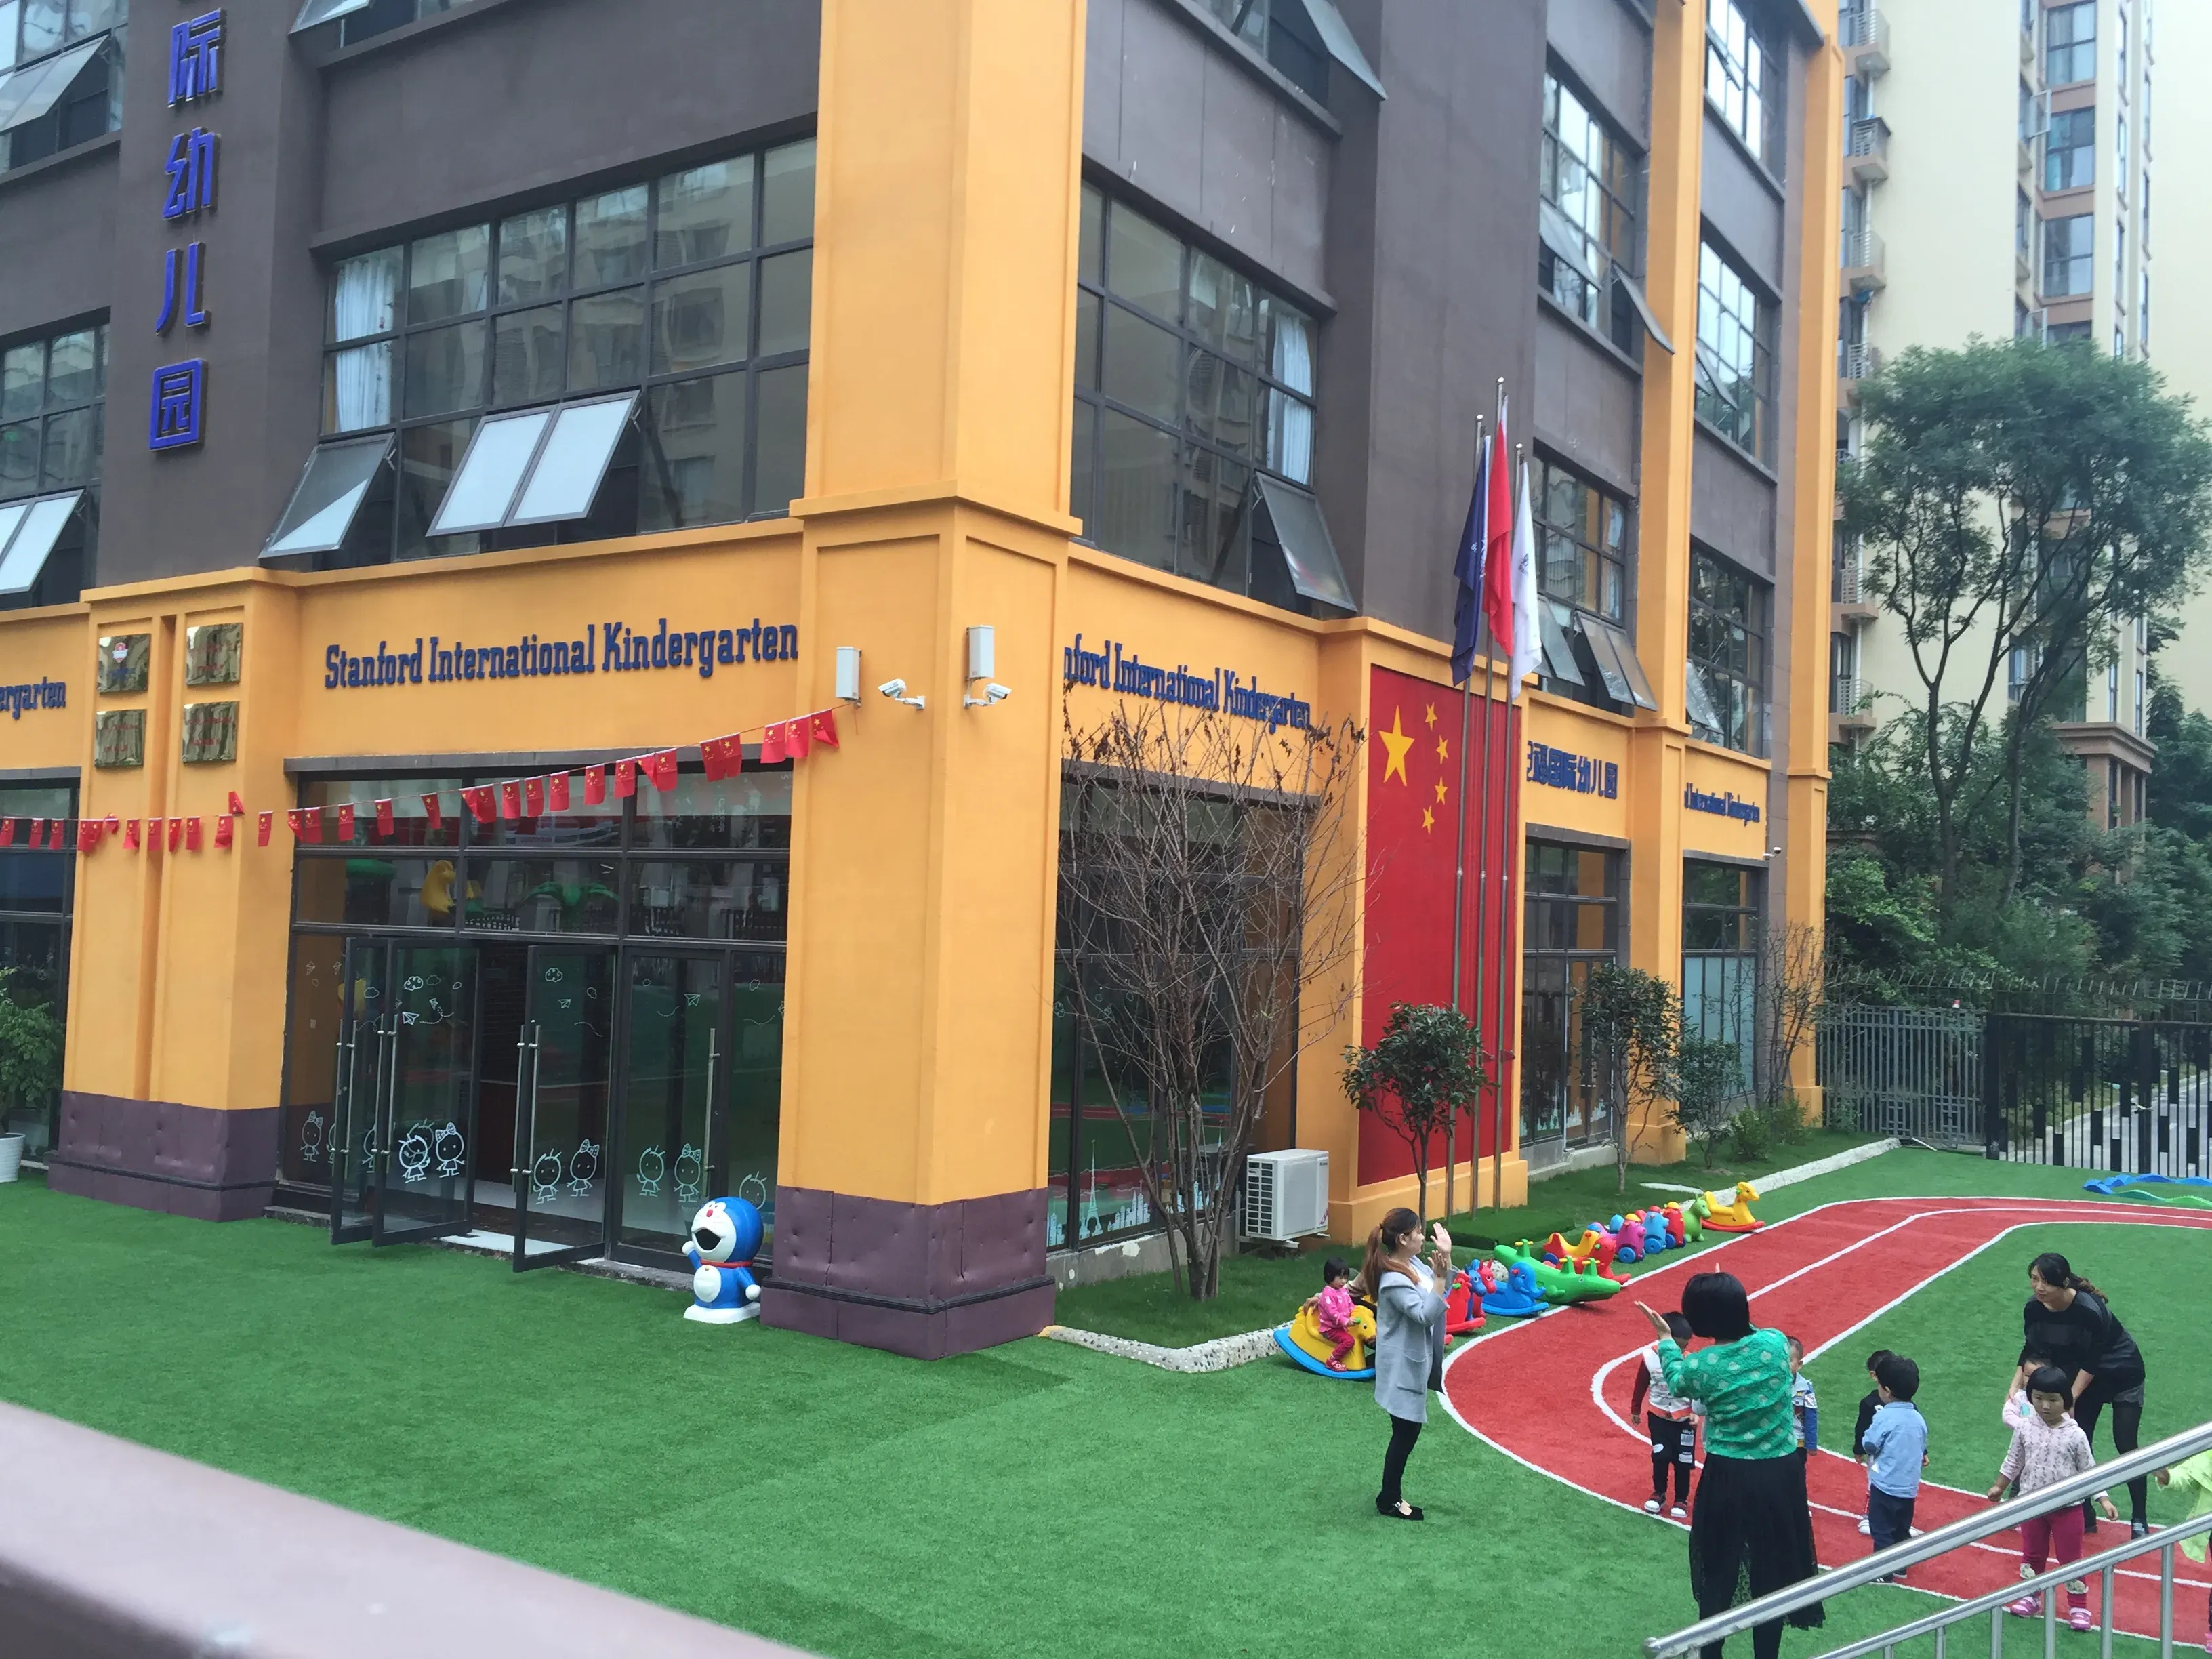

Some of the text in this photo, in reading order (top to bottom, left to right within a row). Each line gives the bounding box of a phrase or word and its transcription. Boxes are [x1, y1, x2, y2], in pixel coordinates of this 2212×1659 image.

[325, 617, 798, 689] Stanford International Kindergarten
[1113, 642, 1220, 712] International
[1223, 669, 1311, 735] Kindergarten
